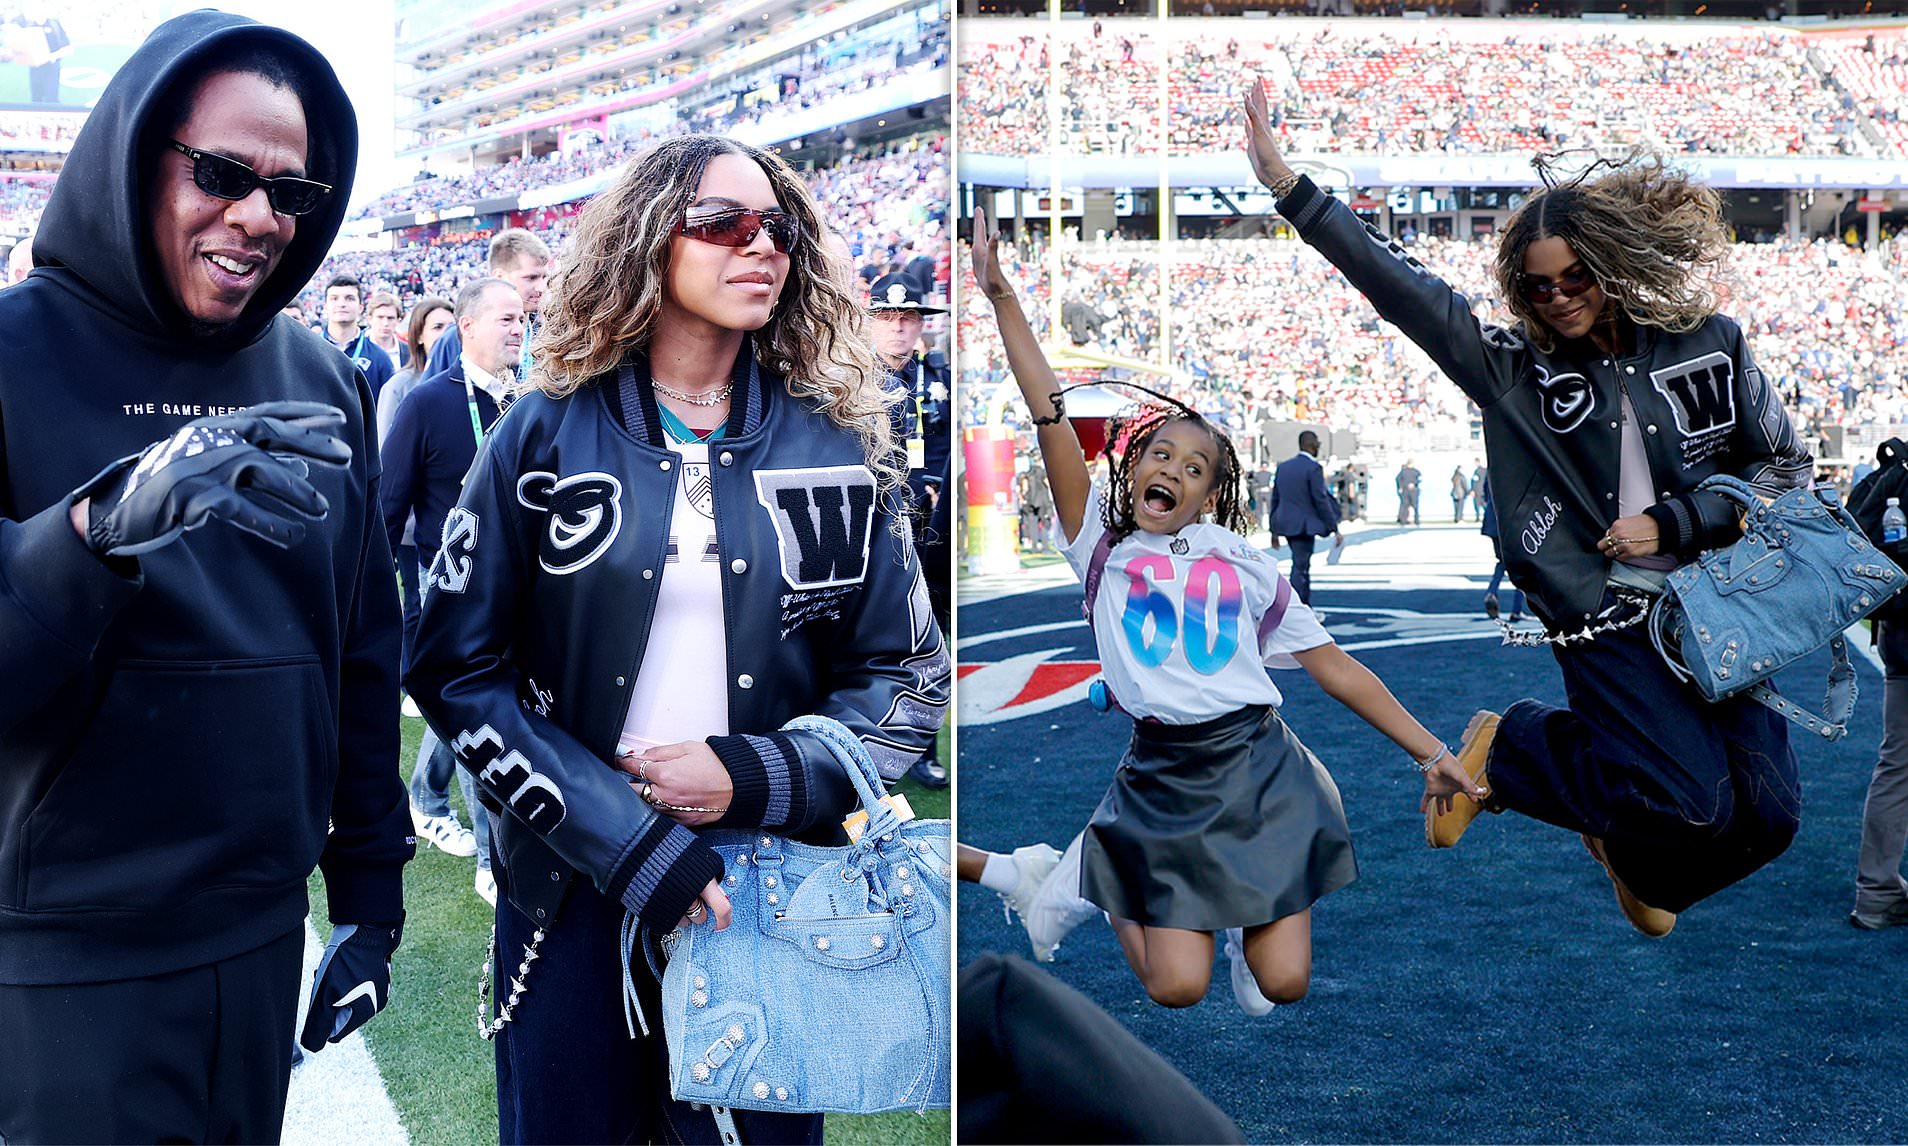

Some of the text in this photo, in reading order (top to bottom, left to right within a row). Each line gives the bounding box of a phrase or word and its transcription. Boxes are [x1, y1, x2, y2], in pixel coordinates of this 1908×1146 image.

[123, 403, 255, 417] THE GAME NEE
[1656, 356, 1734, 435] W
[686, 466, 700, 476] 13
[766, 475, 876, 588] W
[1521, 496, 1562, 554] Abloh
[1121, 555, 1242, 676] 60
